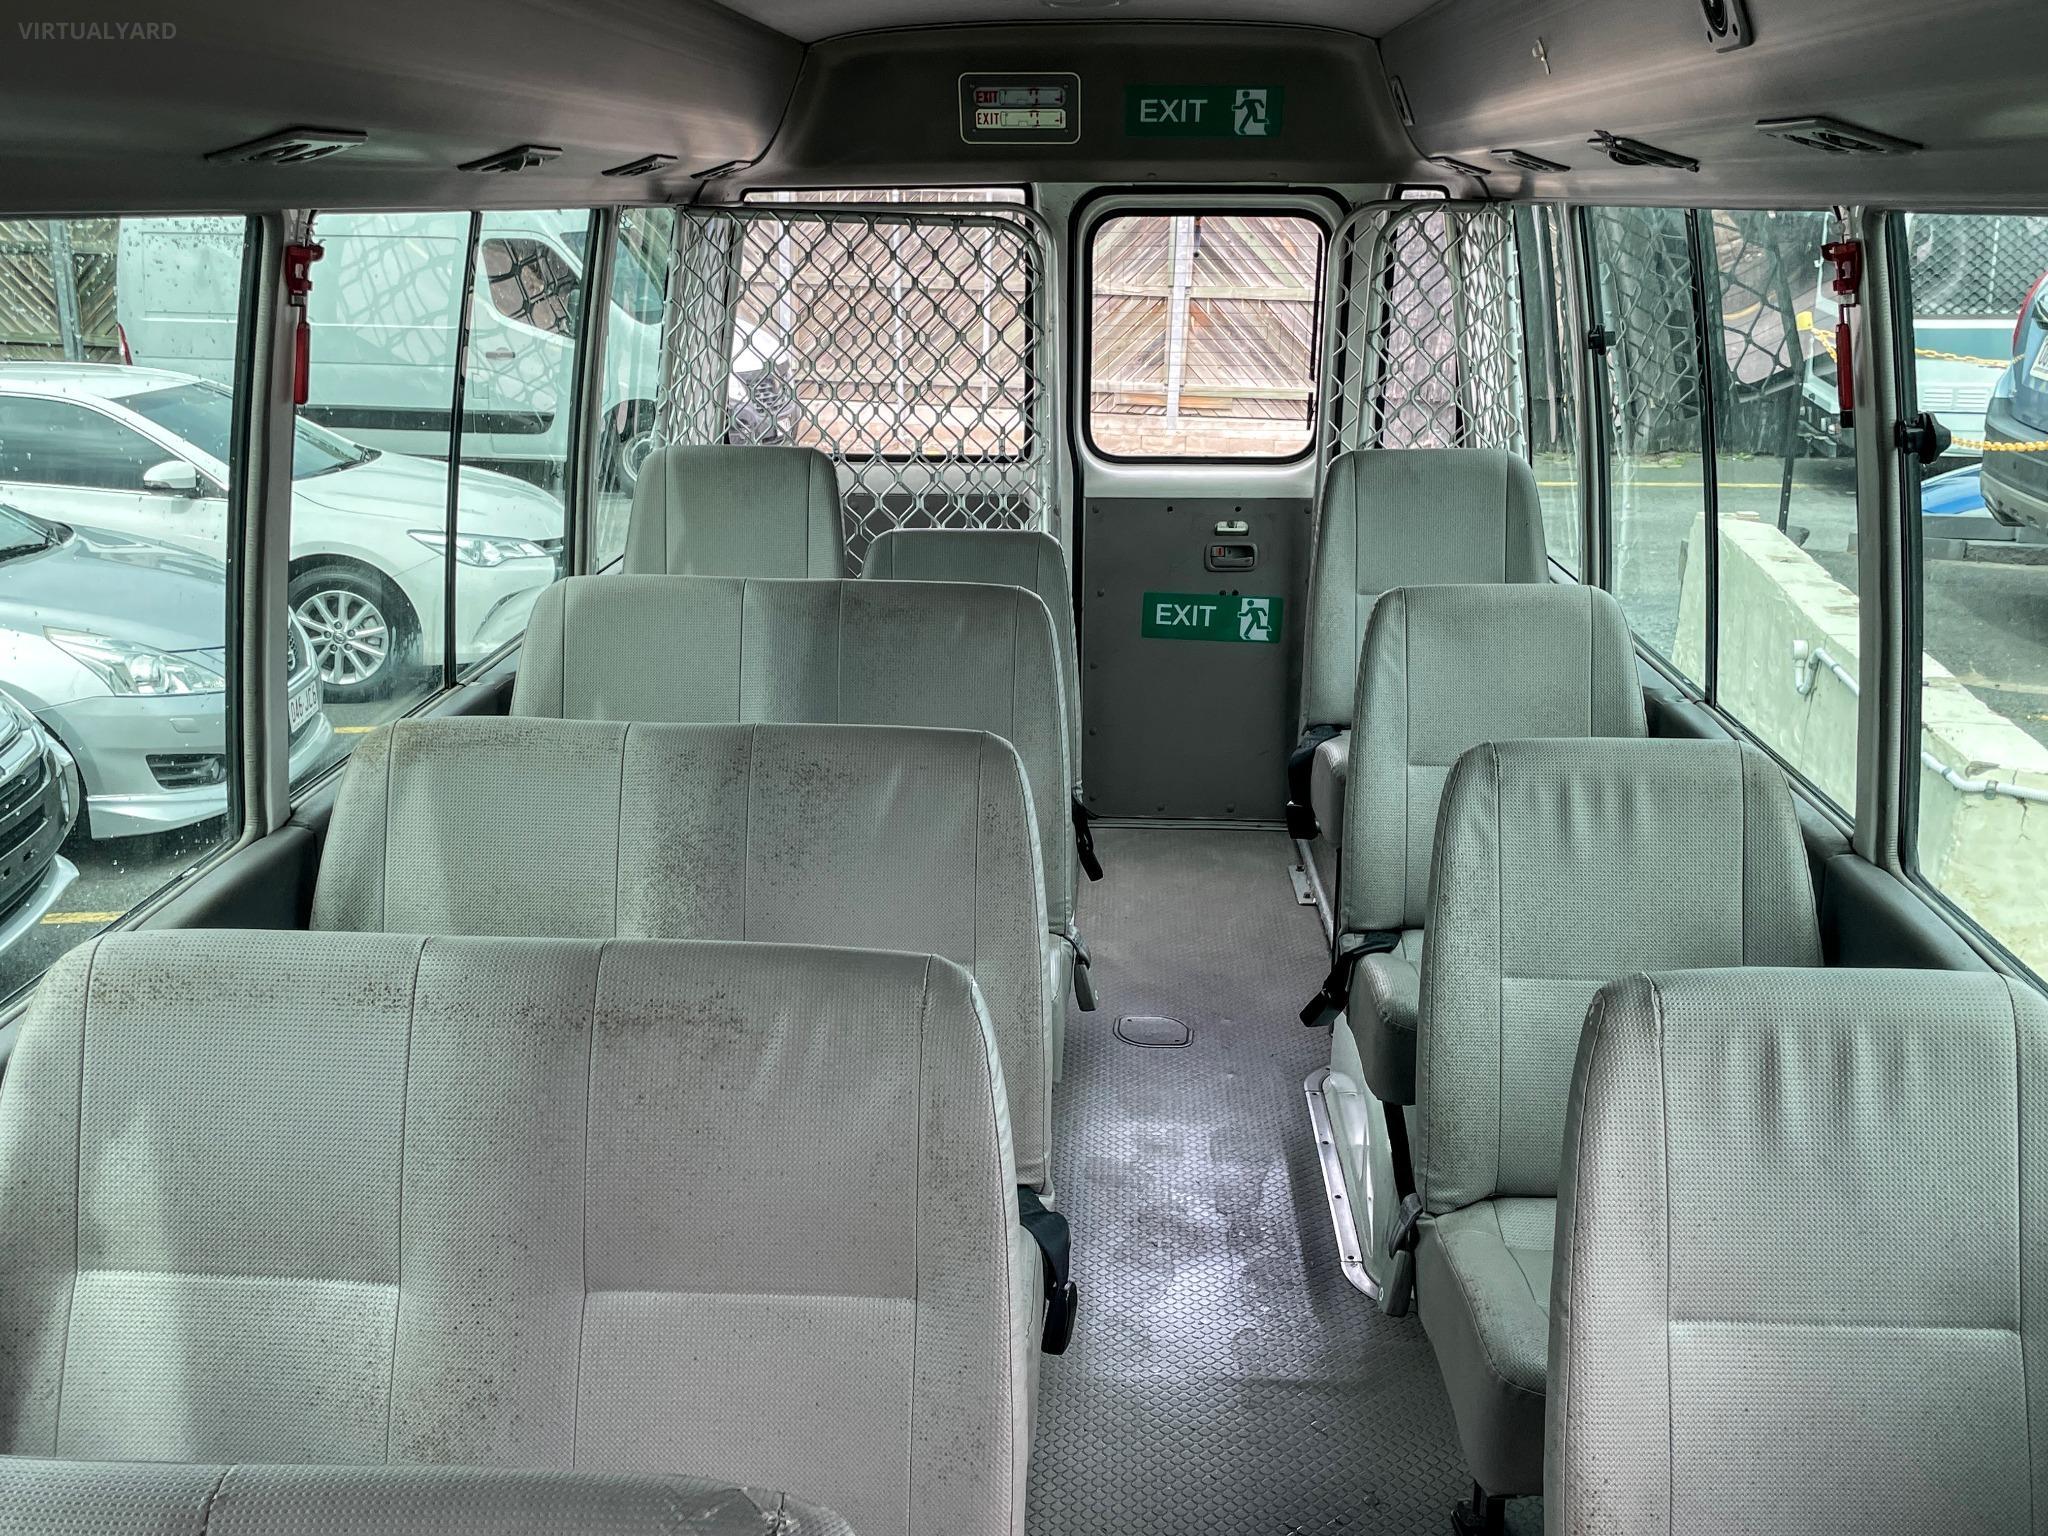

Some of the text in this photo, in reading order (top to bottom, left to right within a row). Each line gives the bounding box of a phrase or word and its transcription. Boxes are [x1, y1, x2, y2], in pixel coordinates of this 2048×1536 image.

[975, 90, 998, 104] EXIT
[977, 112, 999, 125] EXIT
[1140, 99, 1209, 123] EXIT
[1155, 603, 1217, 627] EXIT
